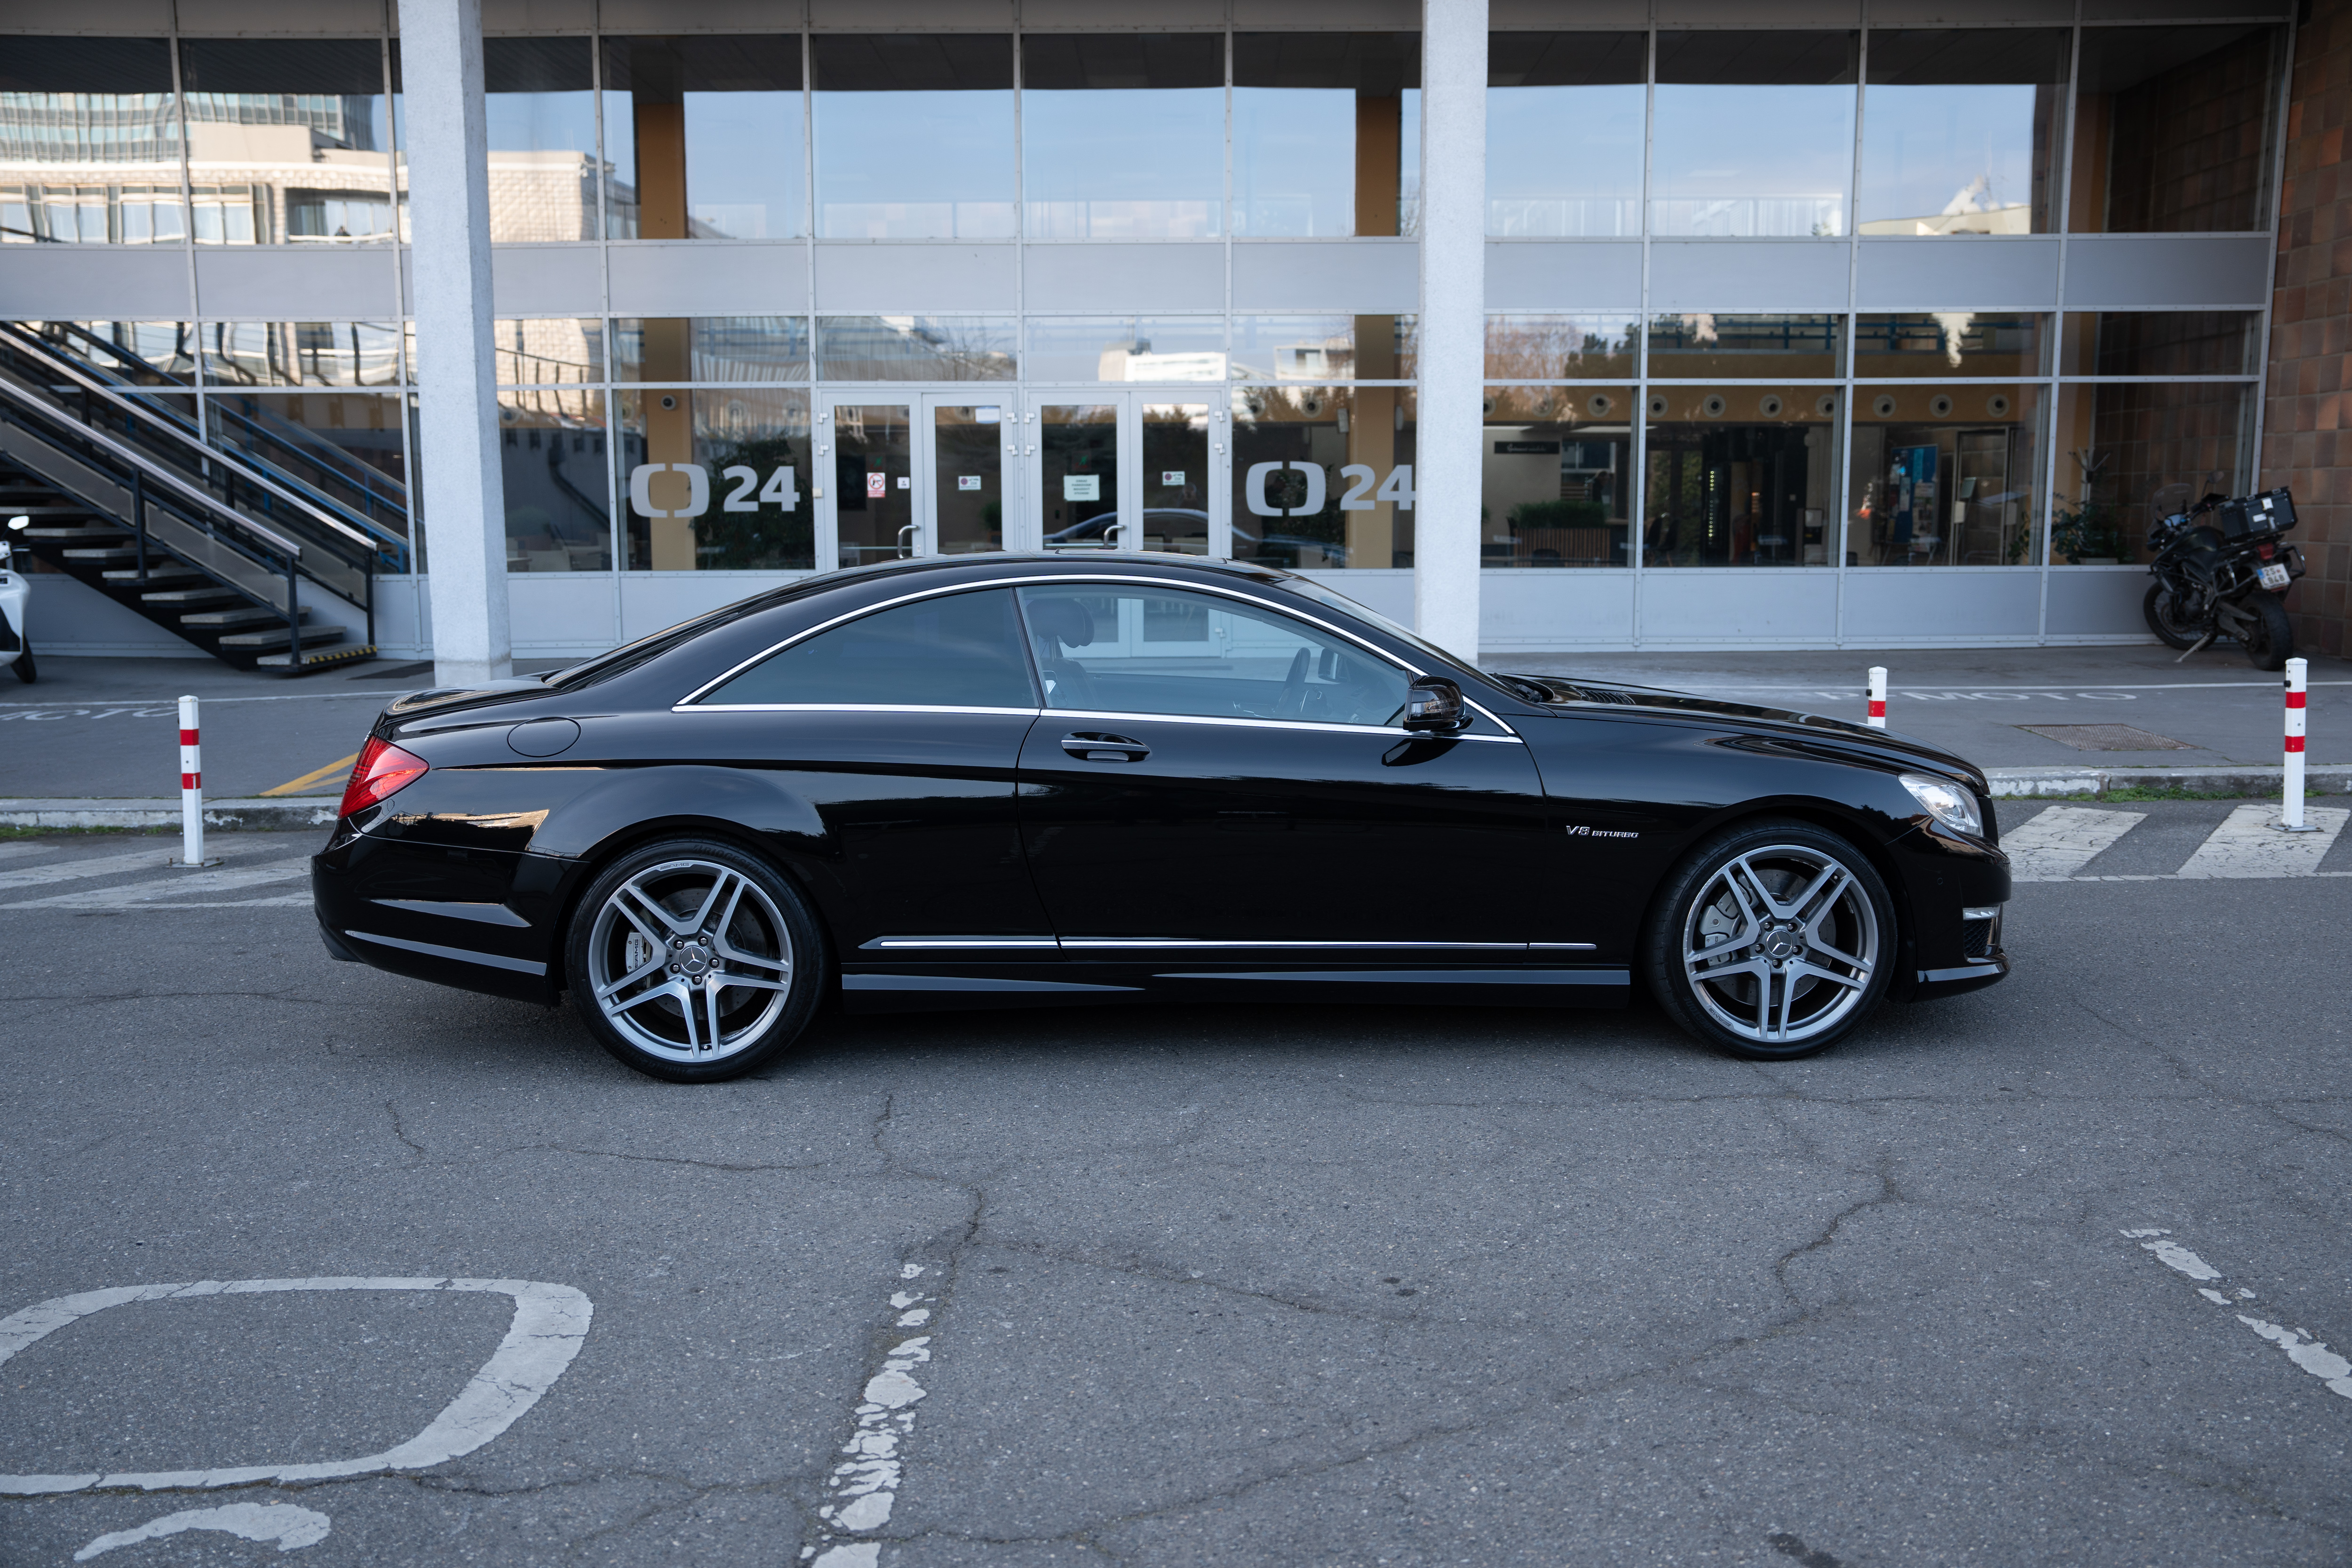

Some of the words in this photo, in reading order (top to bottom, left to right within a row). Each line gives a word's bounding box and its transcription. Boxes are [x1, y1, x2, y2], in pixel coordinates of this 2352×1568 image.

[723, 465, 800, 512] 24
[1340, 464, 1415, 510] 24
[1900, 692, 2137, 700] MOTO
[1566, 826, 1590, 836] V8
[692, 844, 774, 885] BRIDGESTONE
